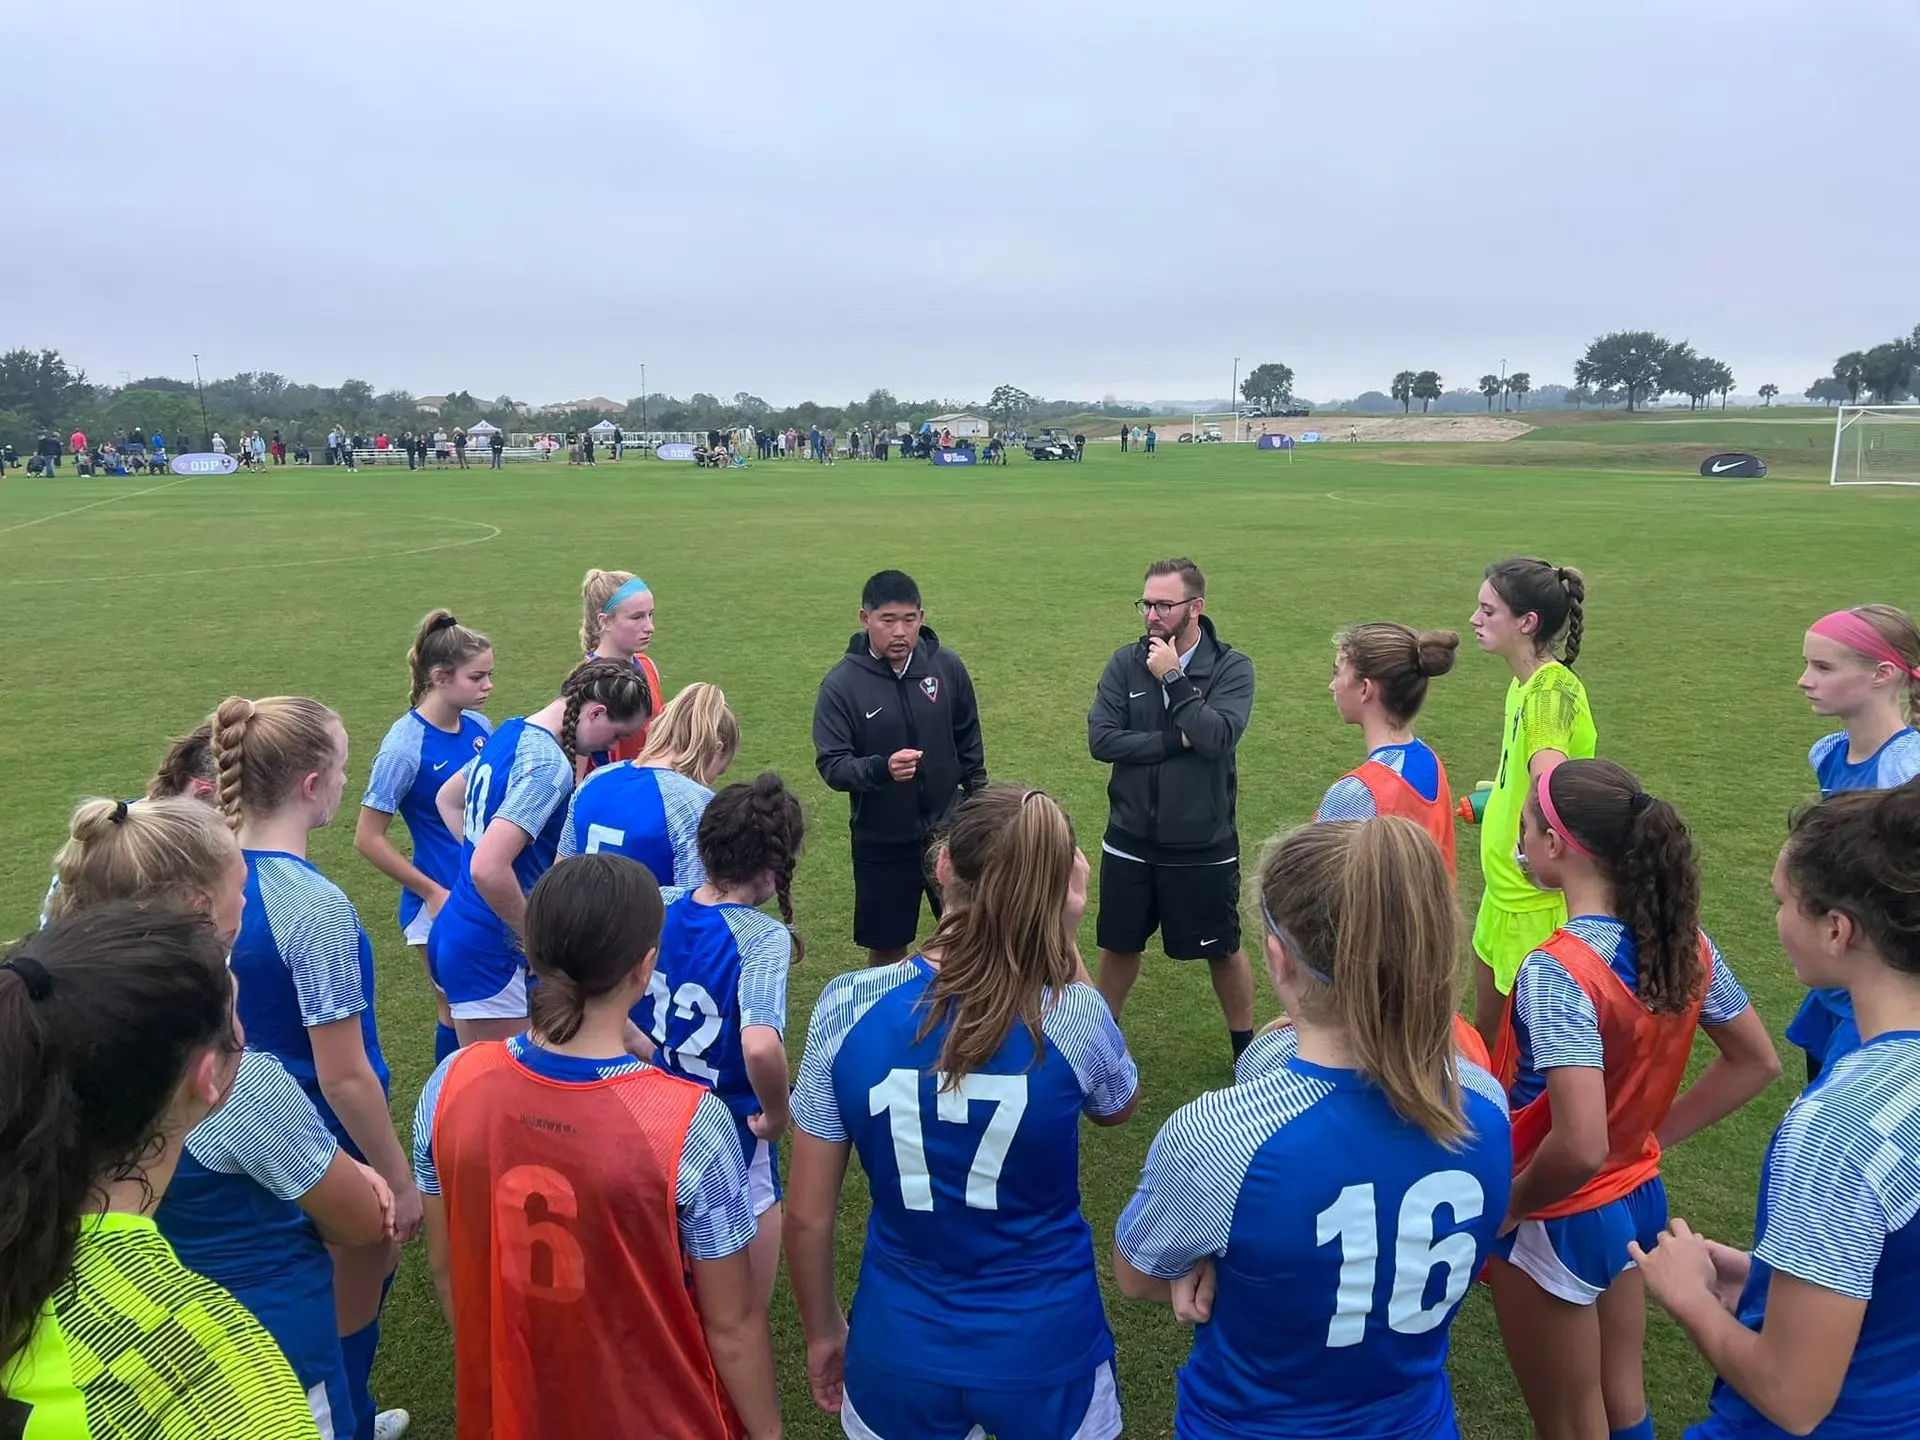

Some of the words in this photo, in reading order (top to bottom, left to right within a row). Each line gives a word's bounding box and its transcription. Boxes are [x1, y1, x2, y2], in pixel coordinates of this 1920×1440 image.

[190, 460, 219, 471] ODP
[645, 969, 723, 1088] 12
[869, 1068, 1028, 1212] 17
[495, 1164, 586, 1303] 6
[1316, 1169, 1485, 1348] 16
